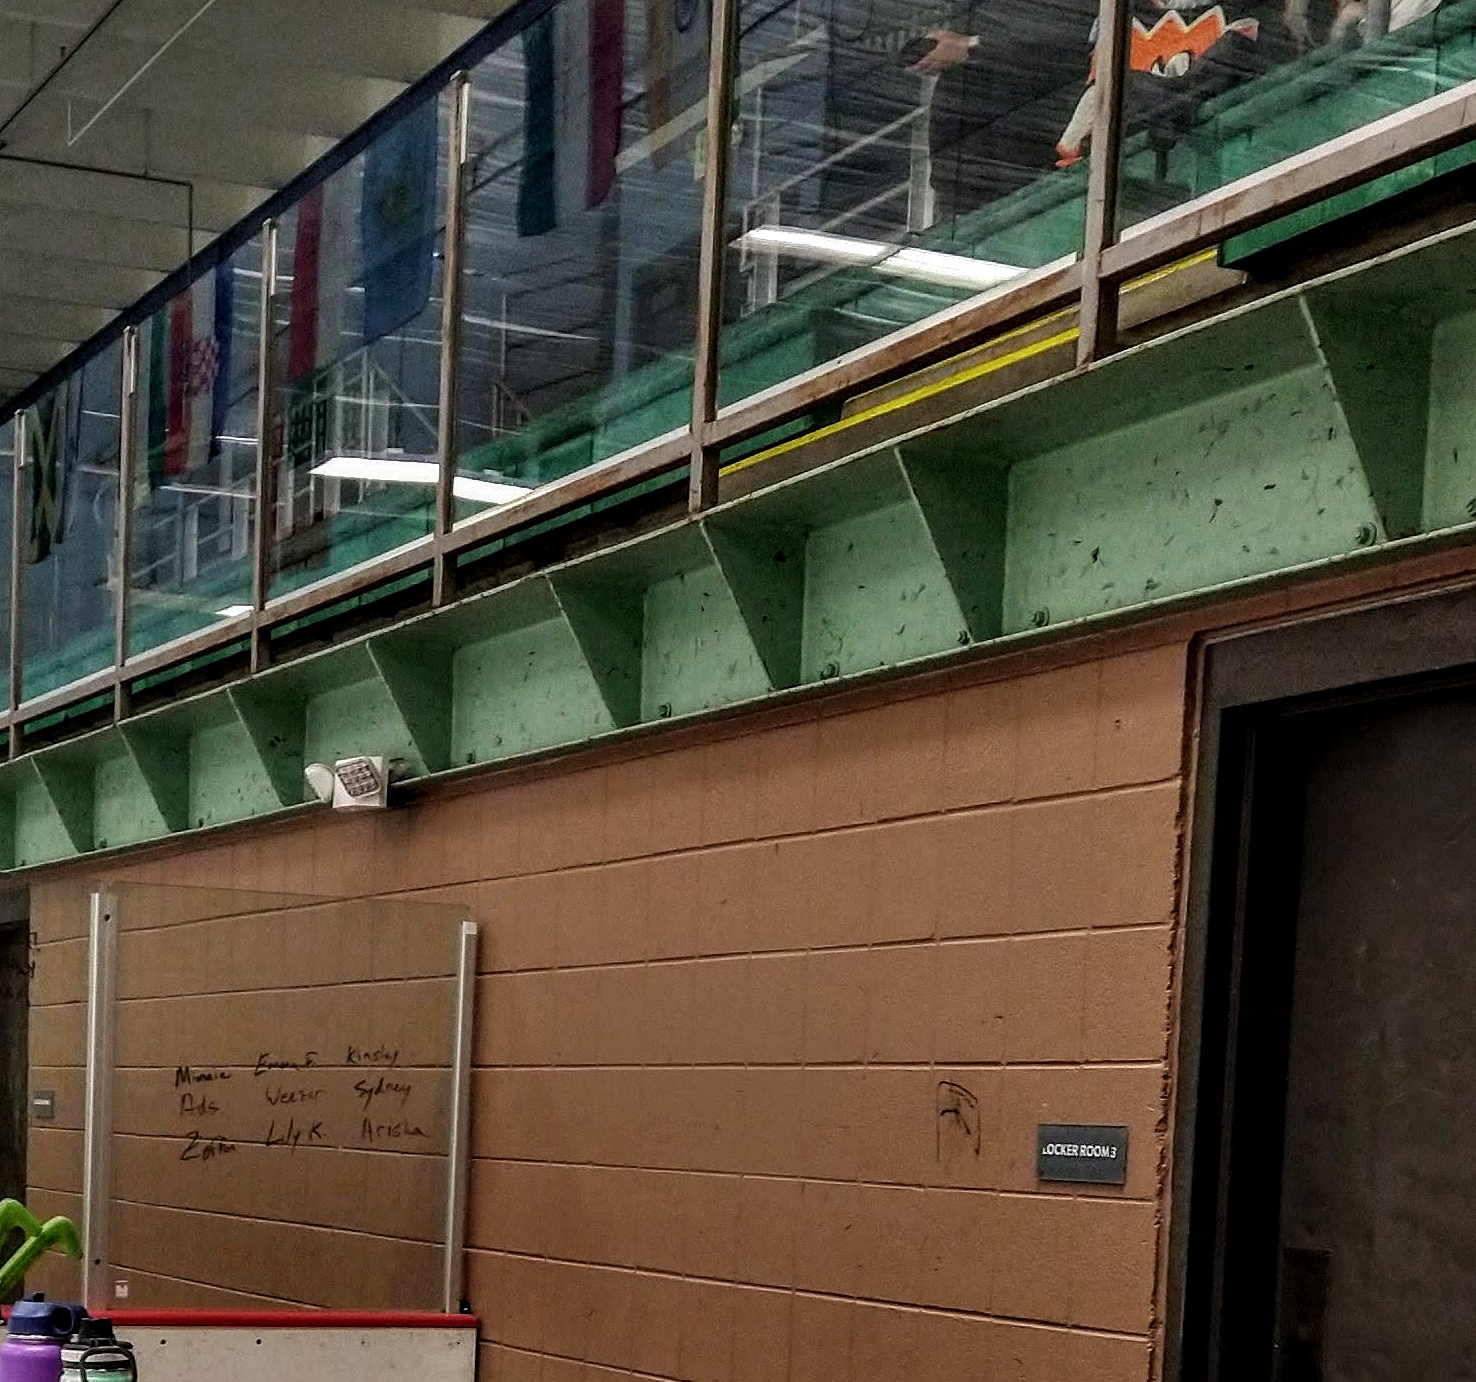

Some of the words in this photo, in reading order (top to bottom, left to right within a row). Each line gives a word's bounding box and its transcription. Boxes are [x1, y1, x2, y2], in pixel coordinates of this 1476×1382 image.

[1042, 1143, 1078, 1156] LOCKER
[1079, 1144, 1109, 1158] ROOM
[1110, 1146, 1118, 1159] 3
